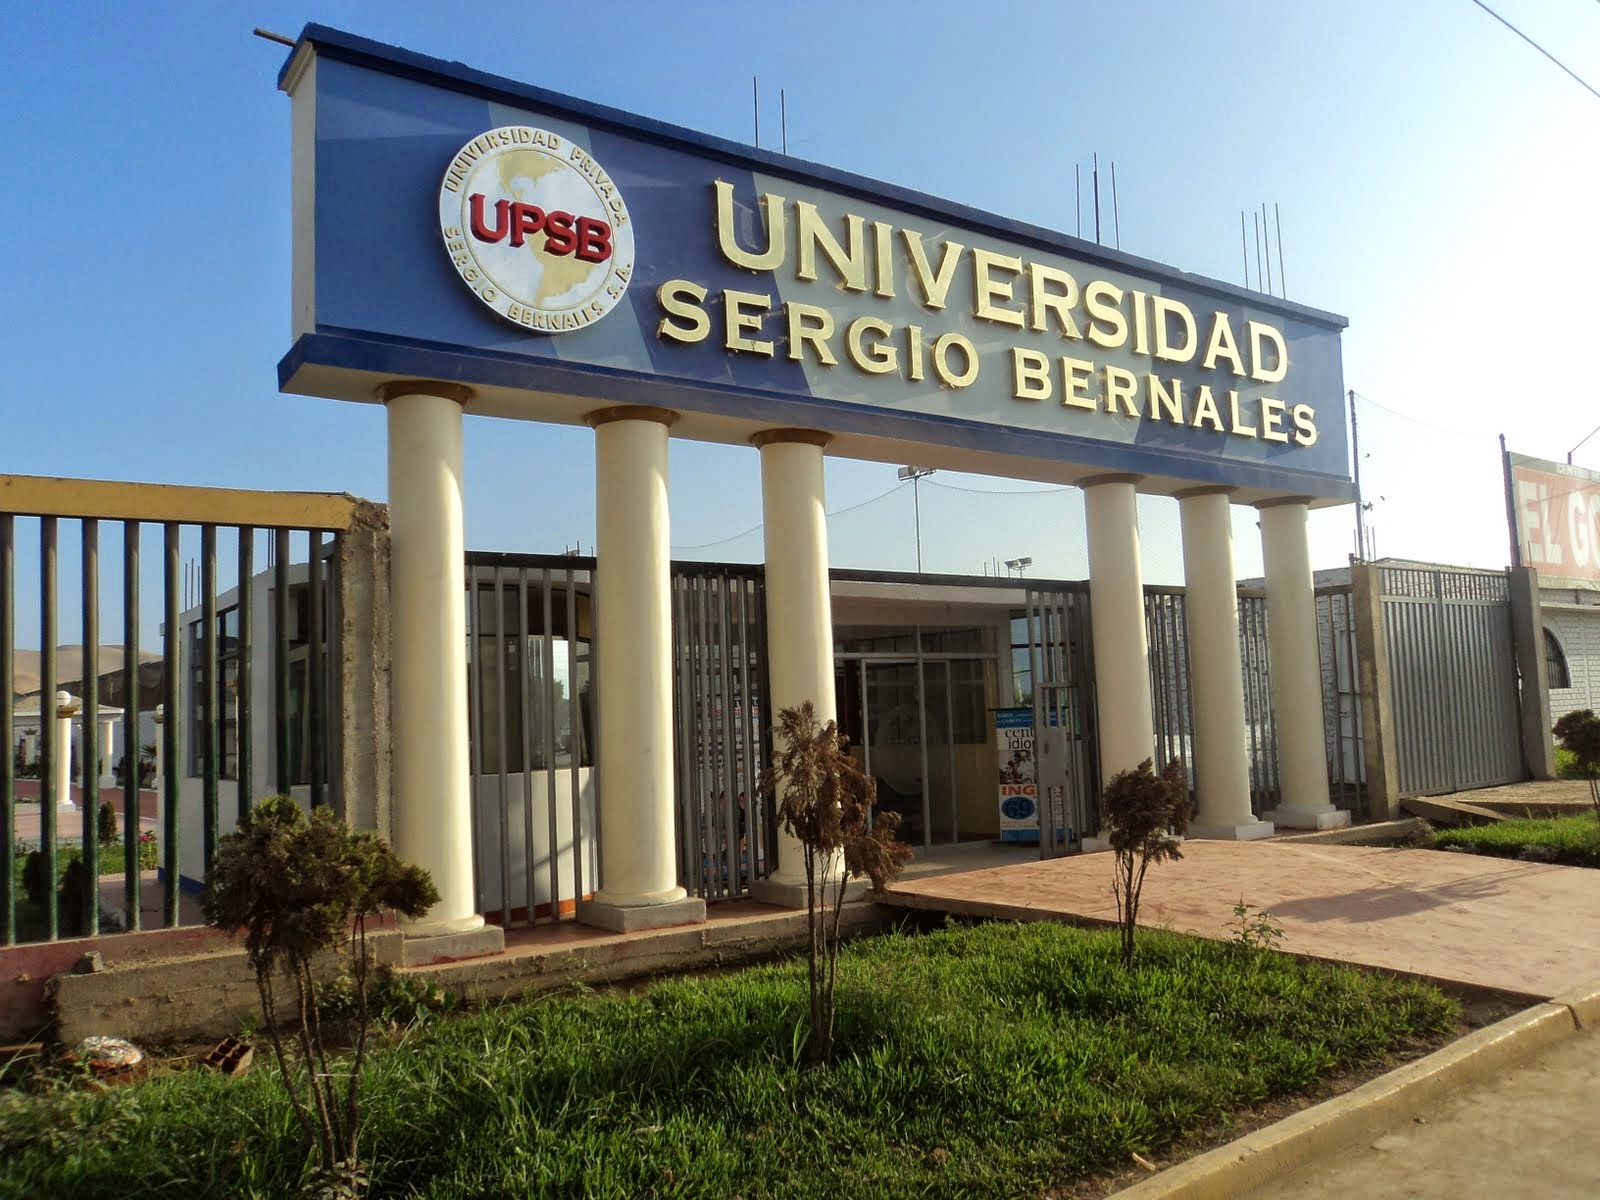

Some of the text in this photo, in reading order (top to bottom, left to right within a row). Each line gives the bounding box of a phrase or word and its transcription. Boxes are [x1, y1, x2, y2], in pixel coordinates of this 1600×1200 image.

[444, 129, 627, 227] UNIVERSIDAD PRIVADA
[469, 193, 612, 263] UPSB
[444, 227, 497, 303] SERGIO
[507, 301, 605, 329] BERNALES
[714, 180, 1288, 383] UNIVERSIDAD
[657, 280, 1319, 446] SERGIO BERNALES
[1518, 480, 1562, 565] EL
[1005, 728, 1034, 738] cent
[1008, 738, 1036, 750] idio
[1002, 786, 1035, 796] ING
